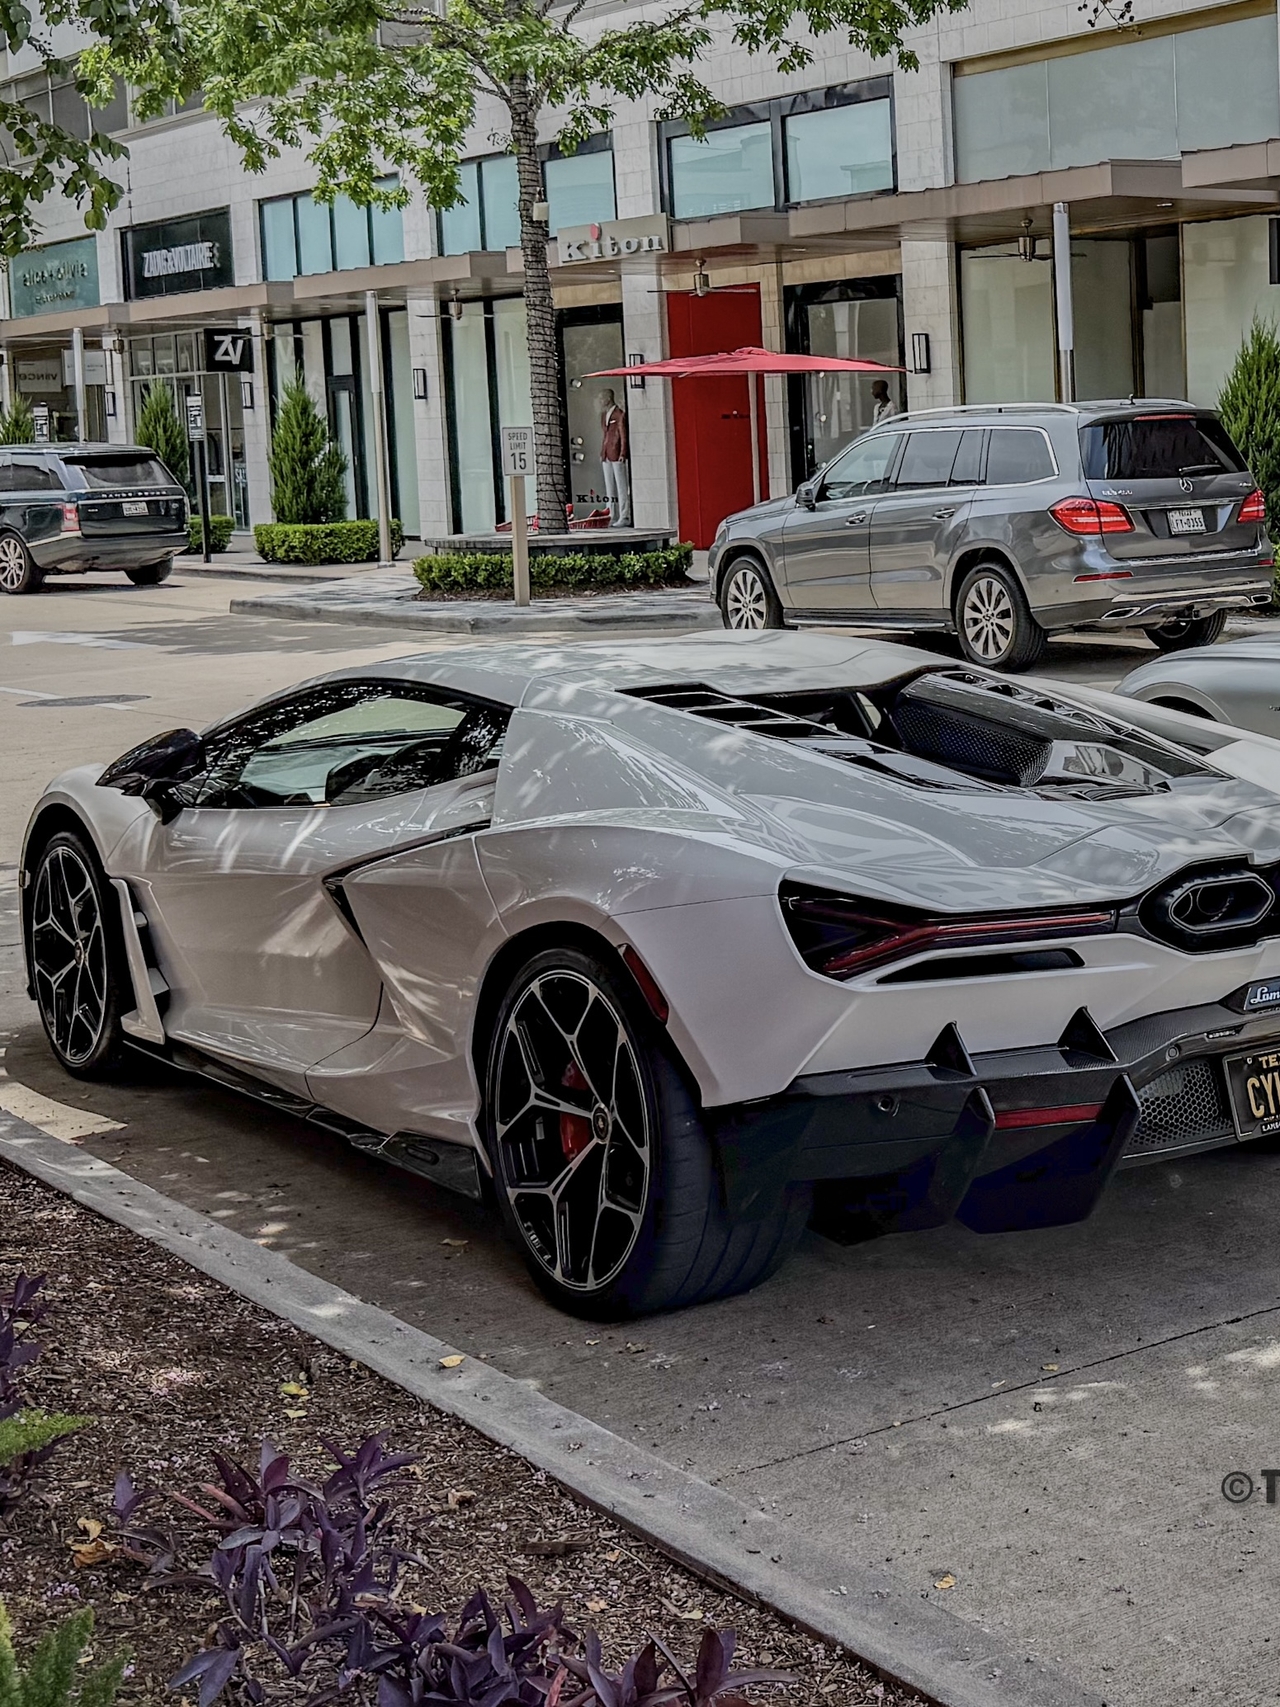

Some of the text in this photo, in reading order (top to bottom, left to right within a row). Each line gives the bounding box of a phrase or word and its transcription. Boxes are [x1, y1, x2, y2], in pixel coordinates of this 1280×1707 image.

[561, 223, 662, 263] Kiton
[507, 432, 528, 441] SPEED
[509, 442, 526, 450] LIMIT
[510, 452, 527, 470] 15
[576, 489, 619, 503] Kiton
